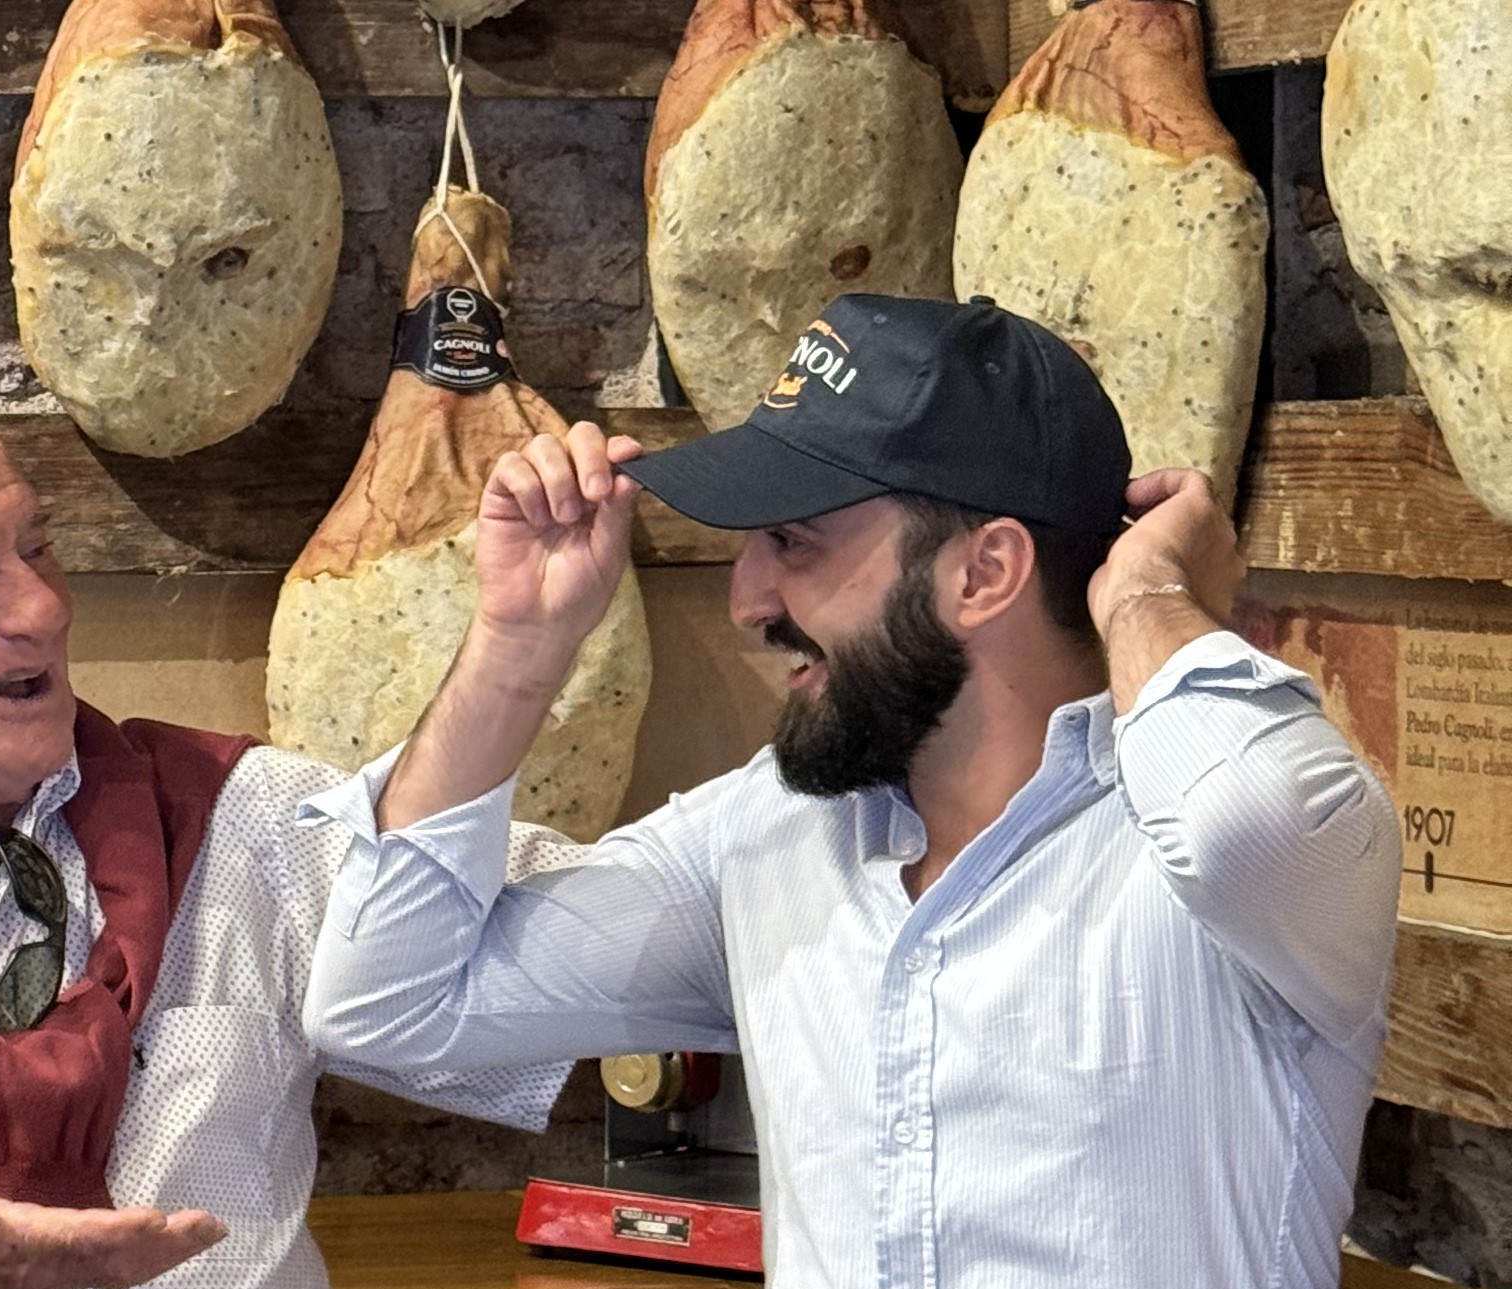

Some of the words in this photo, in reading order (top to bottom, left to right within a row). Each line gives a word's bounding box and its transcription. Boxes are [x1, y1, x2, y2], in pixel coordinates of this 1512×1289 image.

[433, 339, 490, 354] CAGNOLI
[789, 335, 857, 395] NOLI
[1405, 710, 1441, 735] Pedro
[1403, 804, 1455, 847] 1907
